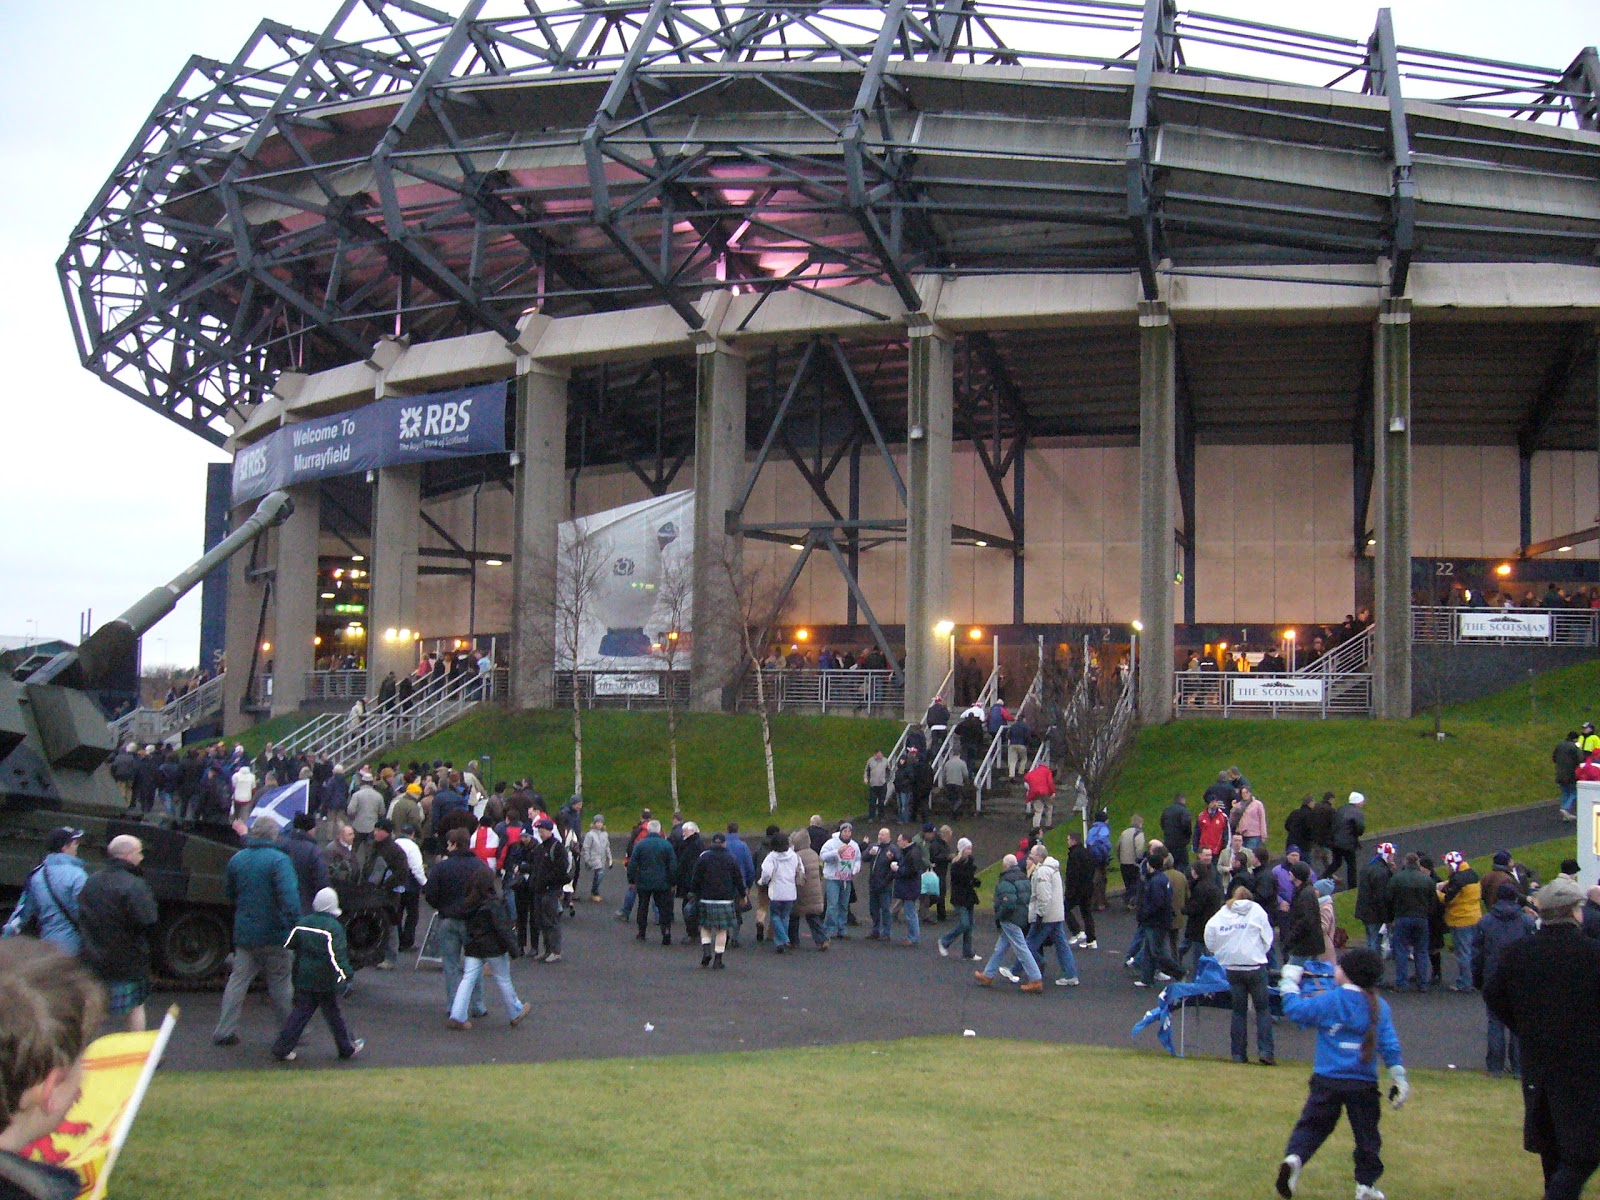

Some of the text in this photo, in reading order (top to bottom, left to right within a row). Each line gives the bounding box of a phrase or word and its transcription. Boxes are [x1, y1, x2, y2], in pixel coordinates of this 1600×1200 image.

[424, 399, 473, 436] RBS
[293, 419, 355, 447] Welcome To
[247, 445, 268, 479] RBS
[294, 443, 350, 471] Murrayfield
[1436, 562, 1454, 576] 22
[1102, 628, 1111, 641] 2
[1465, 622, 1546, 633] THE SCOTSMAN
[1241, 628, 1248, 642] 1
[1238, 688, 1319, 697] THE SCOTSMAN
